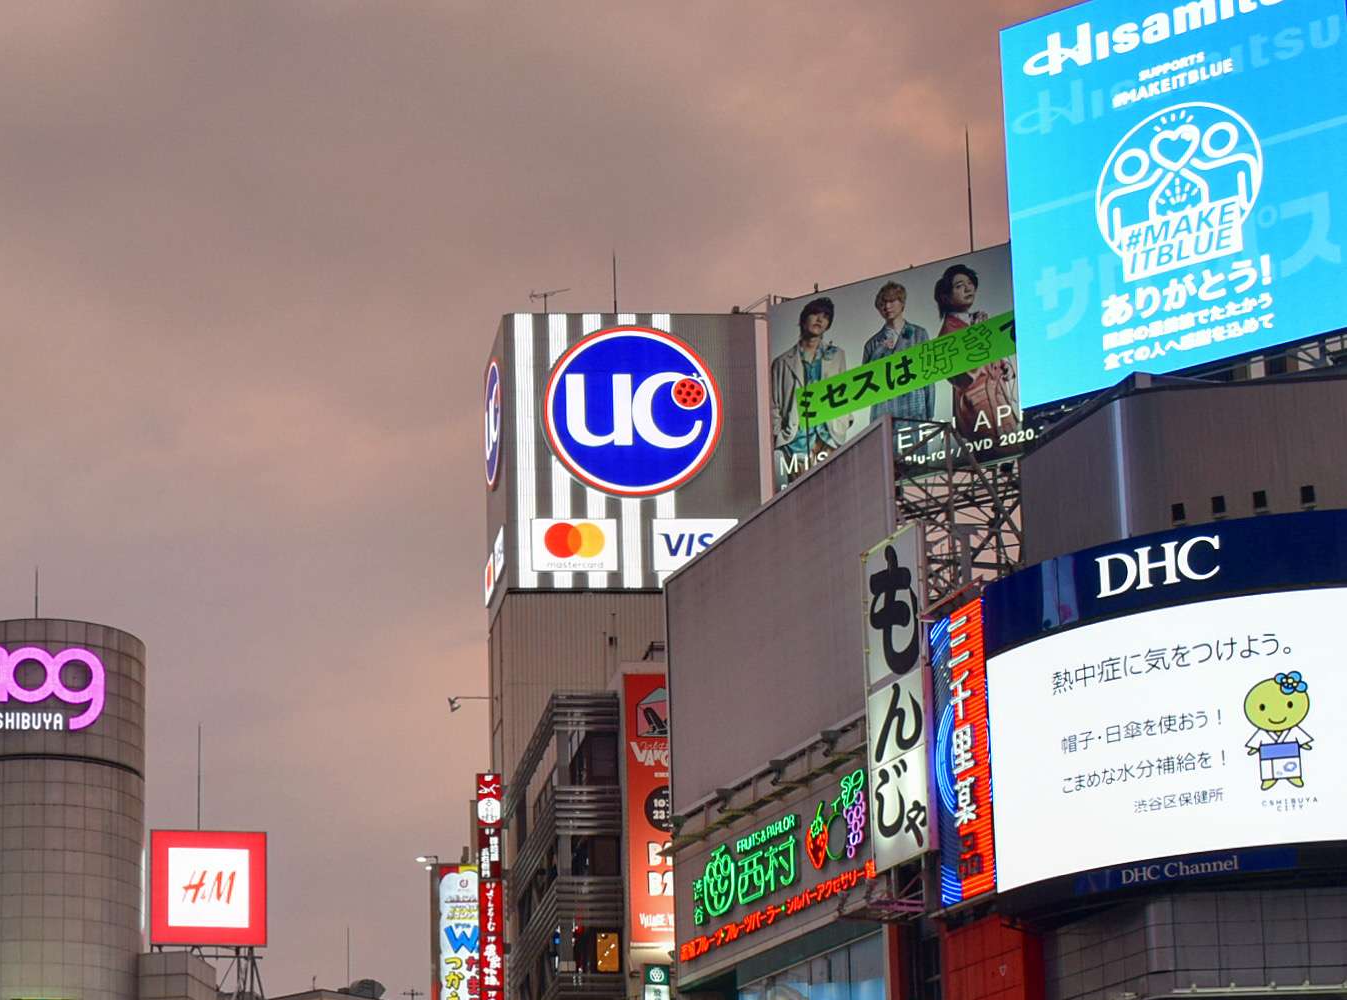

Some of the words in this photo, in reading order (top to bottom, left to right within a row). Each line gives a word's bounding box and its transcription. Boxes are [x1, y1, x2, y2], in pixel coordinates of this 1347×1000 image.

[1111, 58, 1234, 109] #MAKEITBLUE
[1138, 51, 1205, 82] SUPPORTS
[1127, 200, 1237, 250] #MAKE
[1130, 223, 1234, 275] ITBLUE
[546, 560, 604, 569] mastercard
[657, 531, 715, 558] VIS
[1094, 534, 1221, 598] DHC
[1052, 632, 1293, 696] 熱中症に気をつけよう。
[869, 544, 928, 848] もんじゃ
[1133, 787, 1224, 815] 渋谷区保健所
[181, 869, 237, 906] H&M
[738, 835, 797, 905] 西村
[1119, 863, 1161, 886] DHC
[1164, 855, 1240, 880] Channel
